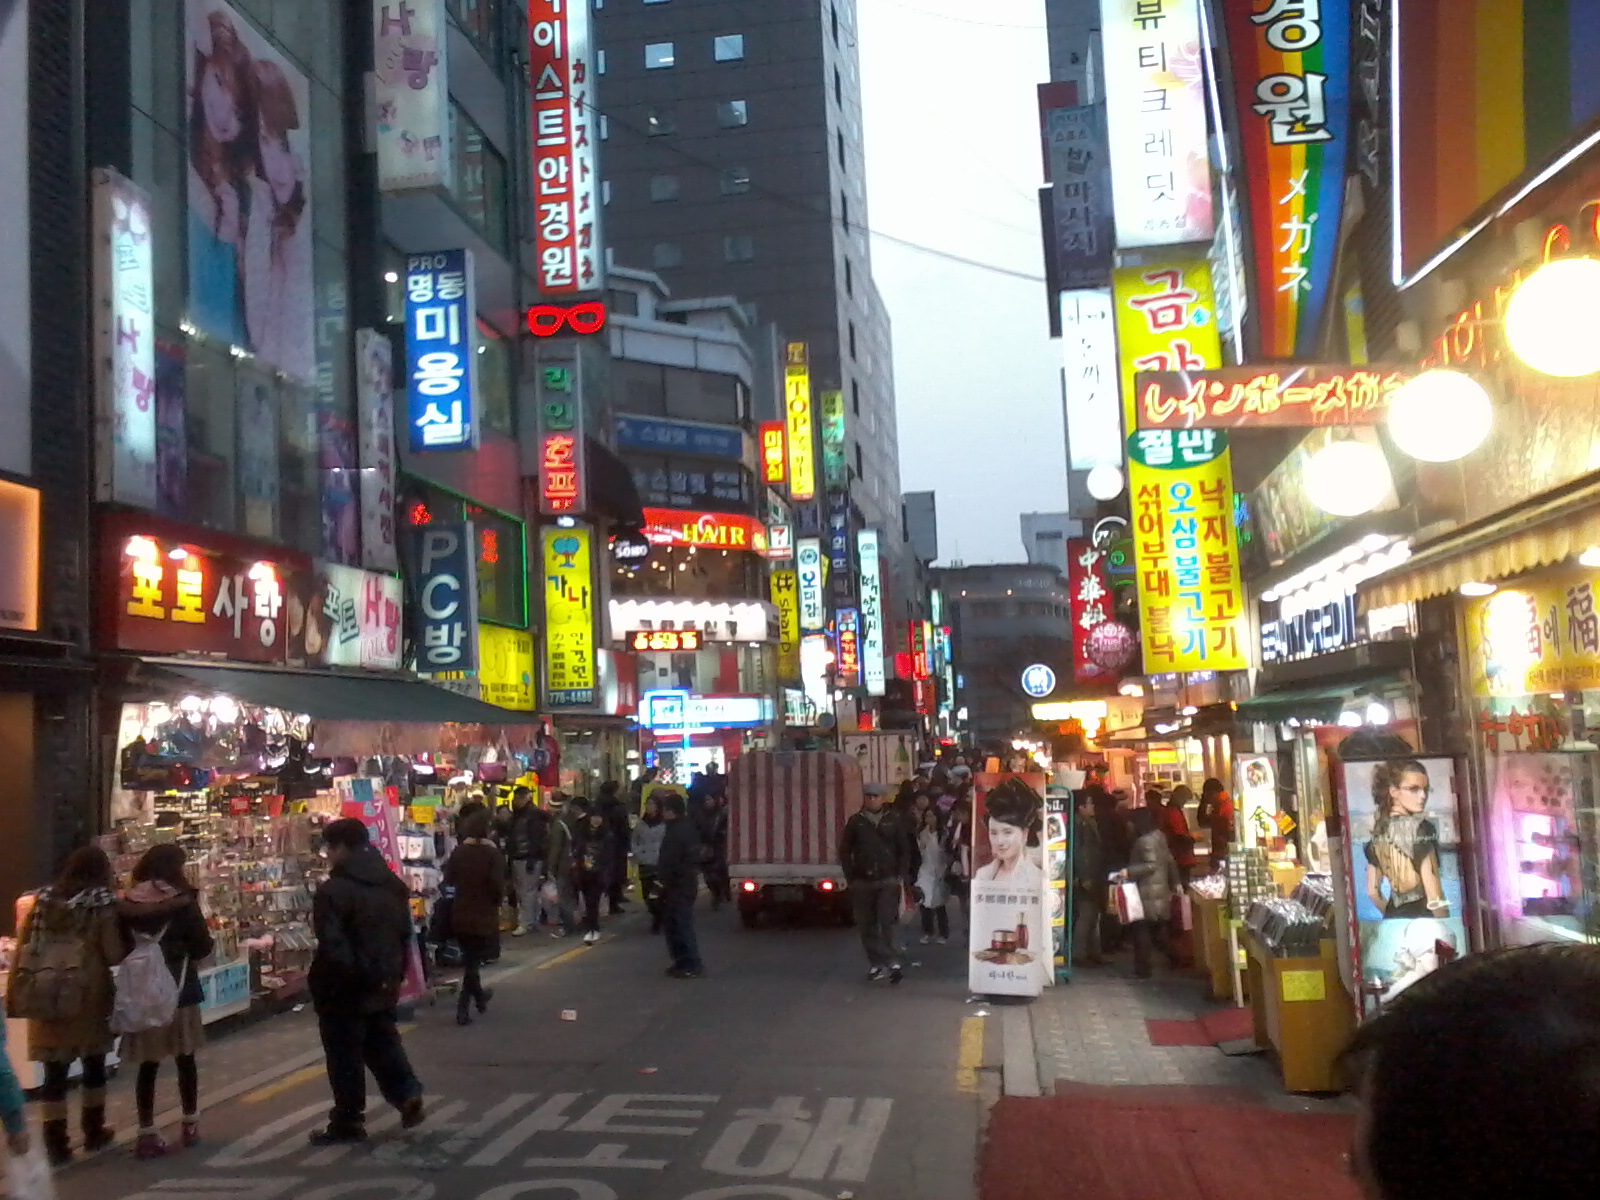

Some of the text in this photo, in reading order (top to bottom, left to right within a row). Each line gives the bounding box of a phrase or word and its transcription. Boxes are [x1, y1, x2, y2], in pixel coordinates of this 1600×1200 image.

[533, 0, 573, 287] 이스트안경원
[407, 254, 448, 272] PRO
[407, 271, 466, 303] 명동
[1278, 168, 1318, 302] メガネ
[413, 303, 465, 446] 미용실
[787, 379, 809, 433] TOP
[420, 530, 468, 665] PC방
[682, 523, 746, 546] HAIR
[1137, 483, 1177, 664] 섞어부대 불낙
[1167, 481, 1208, 661] 오삼불고기
[1198, 478, 1239, 659] 낙지불고기
[570, 632, 588, 679] 안경원
